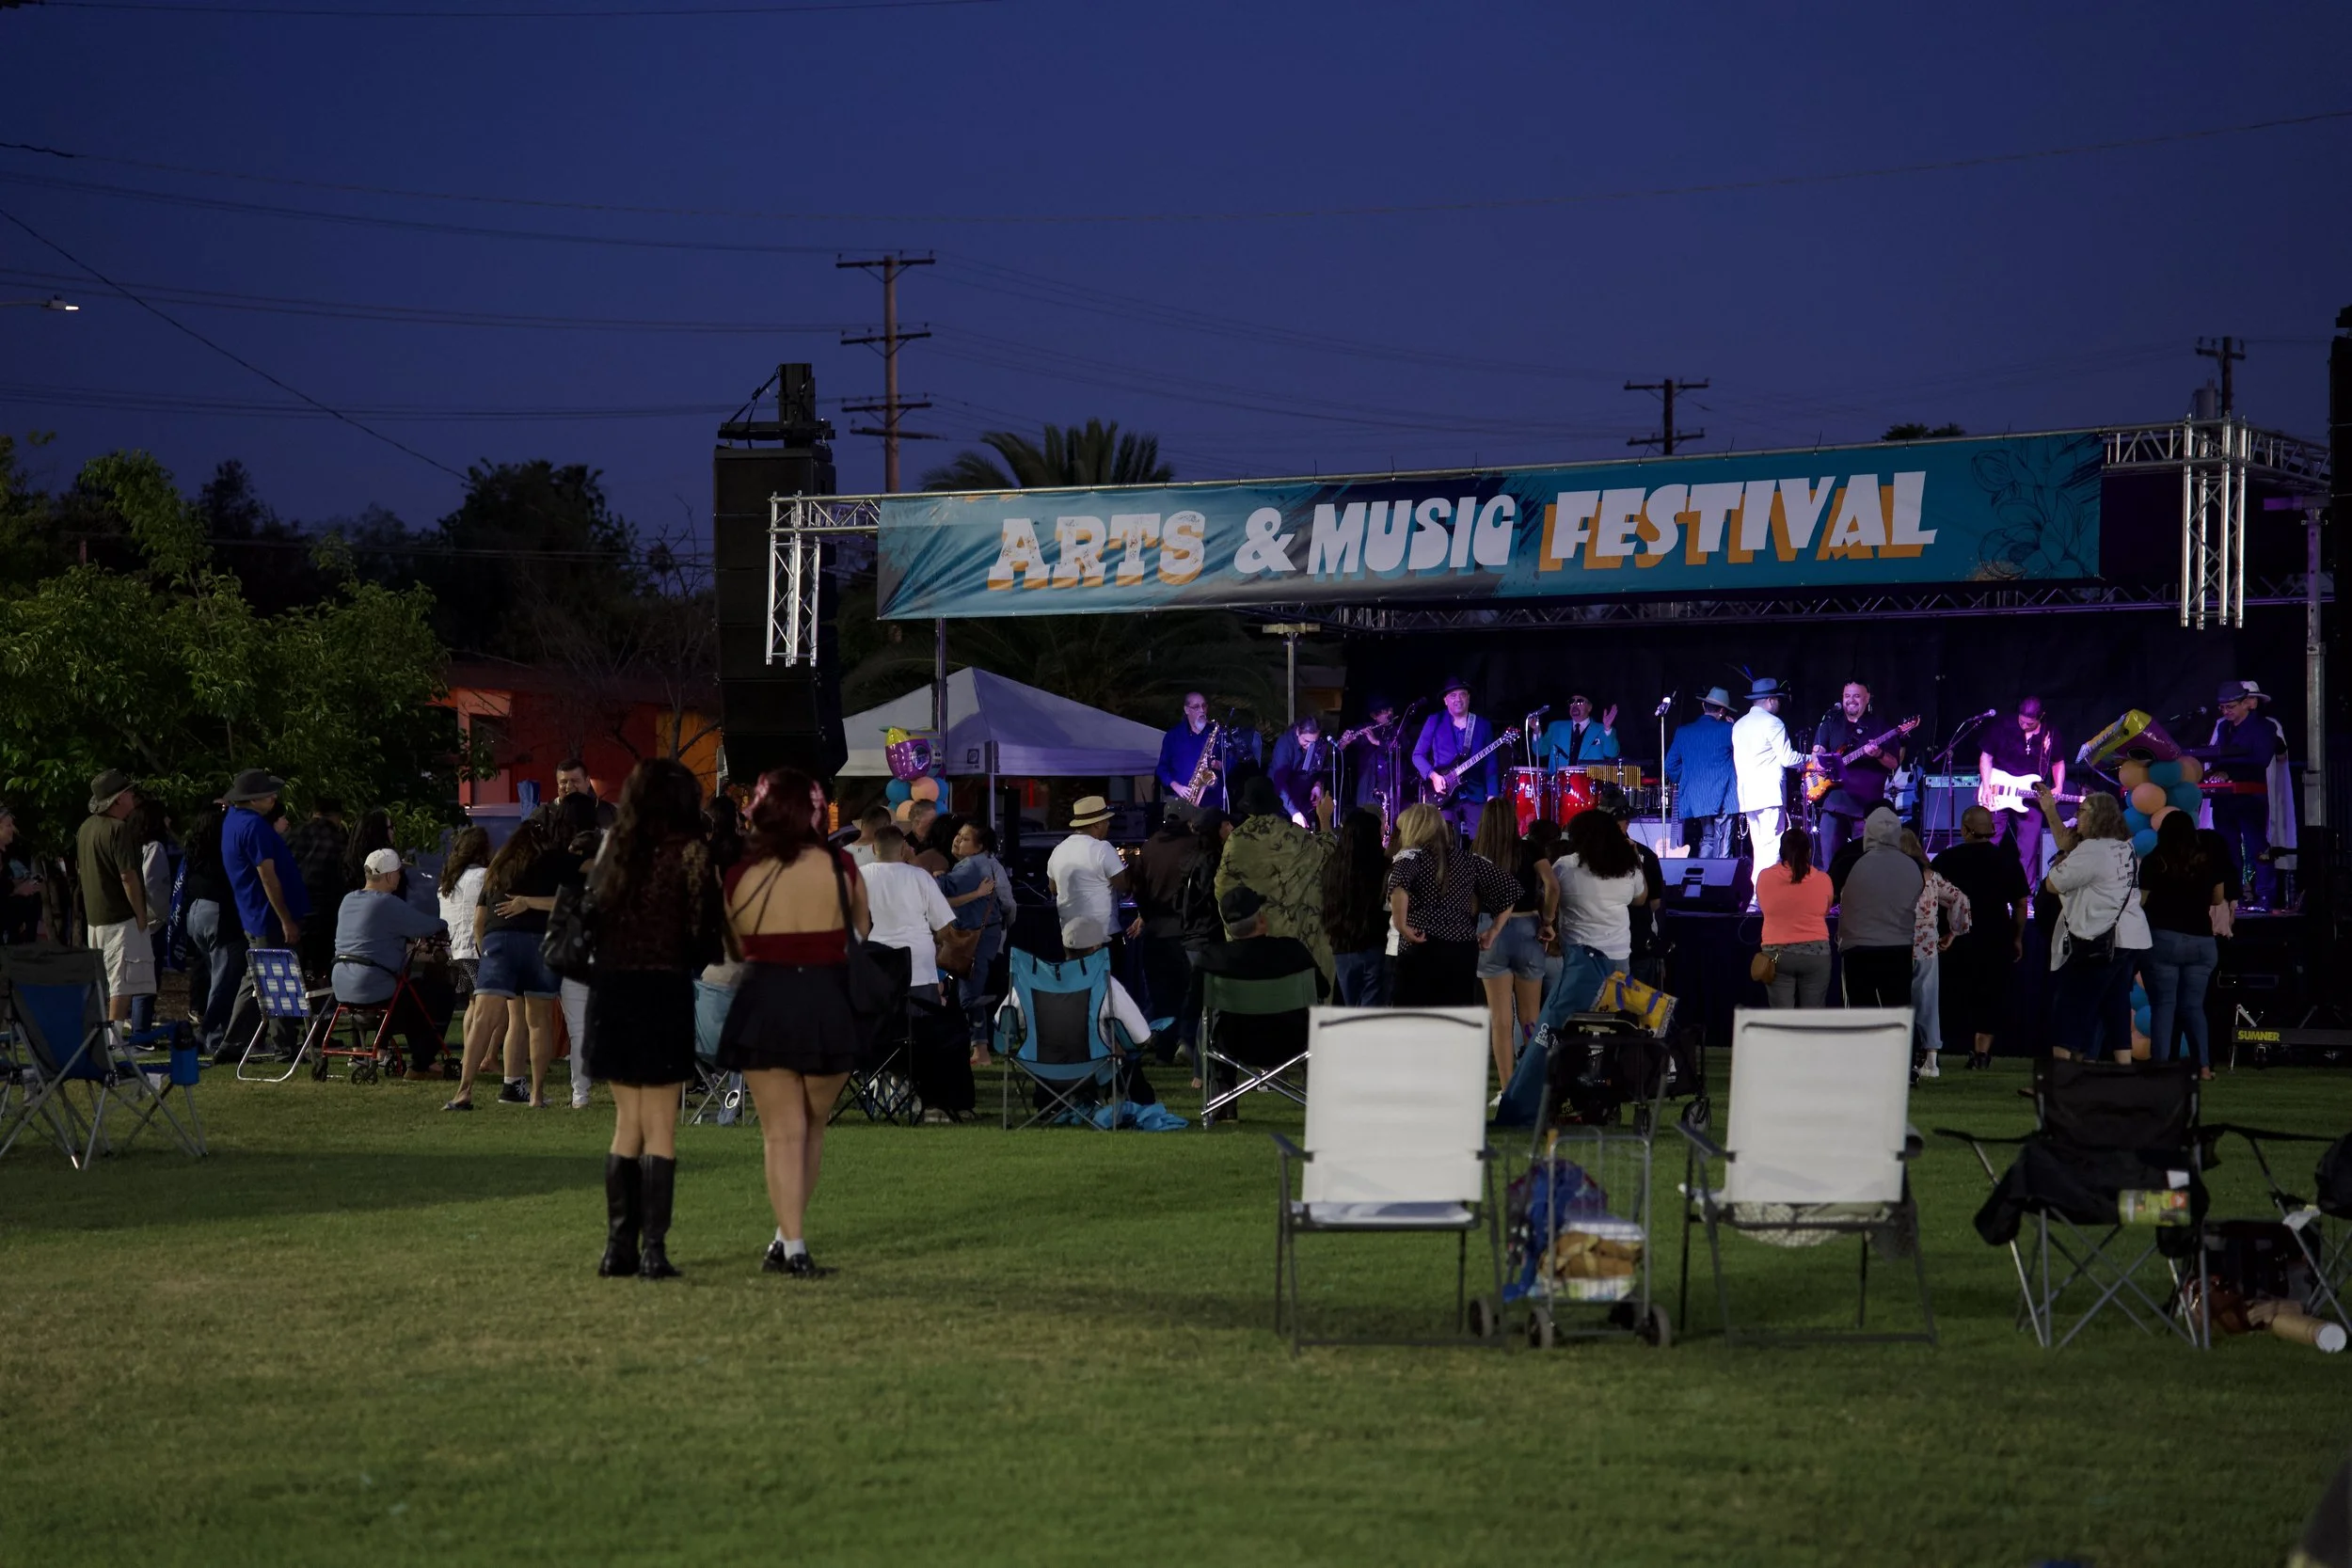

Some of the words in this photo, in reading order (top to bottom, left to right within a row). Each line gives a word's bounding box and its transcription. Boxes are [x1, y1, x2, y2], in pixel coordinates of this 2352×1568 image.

[988, 511, 1206, 589] ARTS
[1234, 507, 1295, 575] &
[1306, 495, 1518, 579] MUSIC
[1546, 471, 1936, 568] FESTIVAL
[2237, 1029, 2280, 1042] SUMNER
